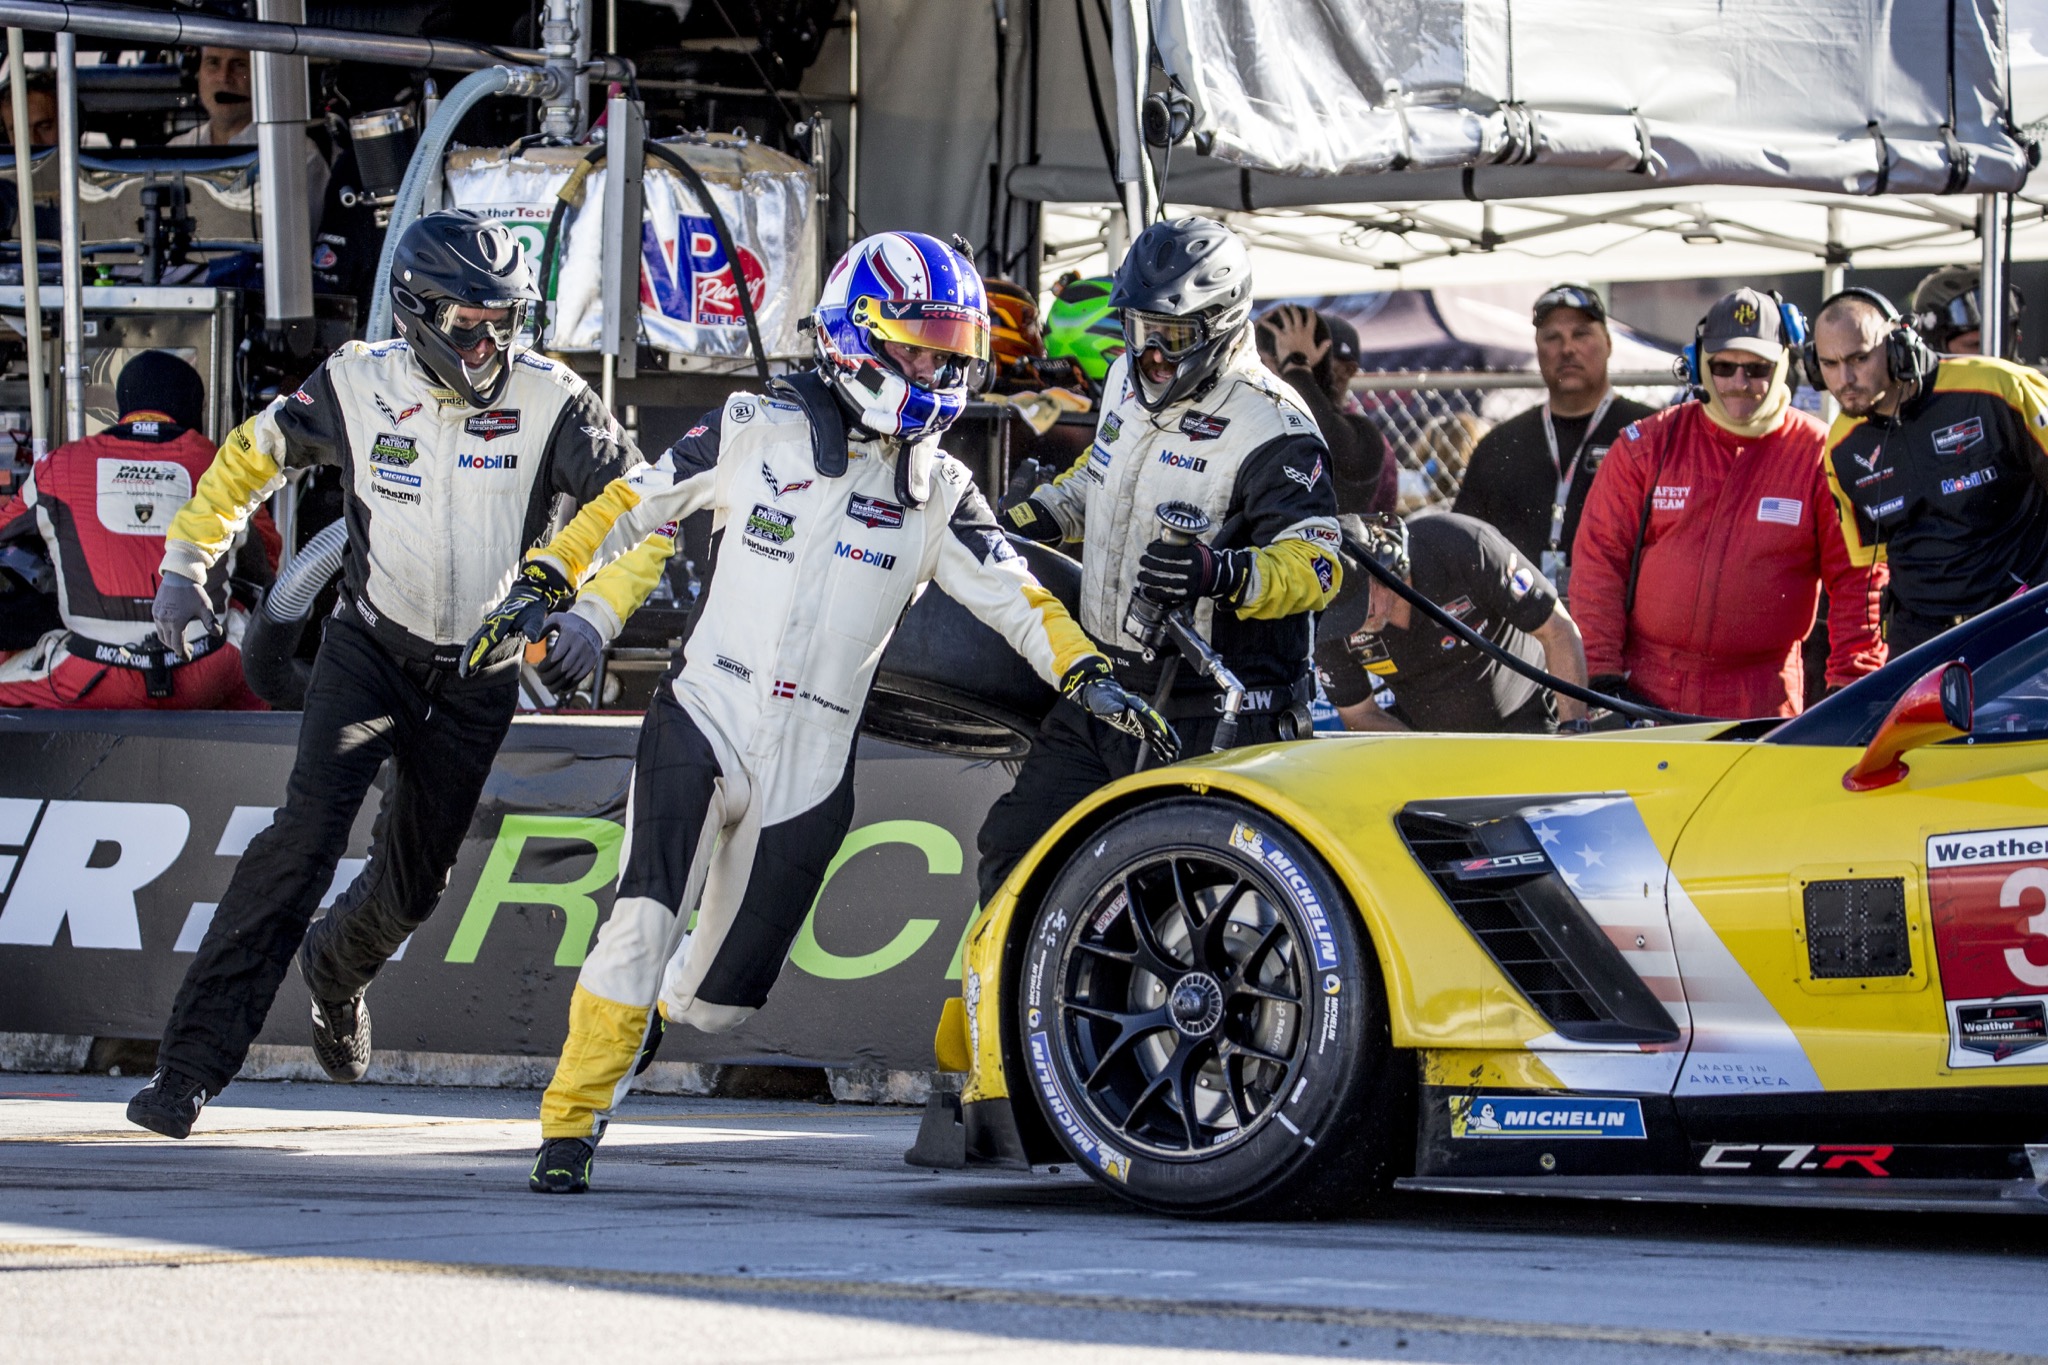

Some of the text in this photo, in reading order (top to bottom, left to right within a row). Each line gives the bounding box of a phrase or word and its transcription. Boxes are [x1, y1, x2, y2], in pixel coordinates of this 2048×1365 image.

[700, 312, 747, 327] FUELS
[133, 422, 159, 433] OMP
[458, 454, 502, 470] Mobil
[1158, 449, 1195, 470] Mobil
[116, 471, 176, 481] MILLER
[120, 465, 160, 474] PAUL
[381, 470, 421, 485] MICHELIN
[1940, 471, 1982, 495] Mobil
[1655, 486, 1691, 497] AFETY
[1653, 499, 1685, 510] TEAM
[833, 541, 884, 566] Mobil
[435, 654, 457, 663] Steve
[1117, 657, 1131, 668] Dix
[812, 693, 850, 715] Magnussen
[1461, 851, 1545, 871] Z06
[1267, 850, 1337, 963] MICHELIN
[2000, 867, 2048, 987] 3
[1029, 963, 1040, 1006] MICHELIN
[1327, 996, 1339, 1041] MICHELIN
[1963, 1018, 2044, 1033] WeatherTech
[1270, 1018, 1286, 1054] RACIN
[1698, 1064, 1768, 1073] MADE IN
[1689, 1075, 1790, 1087] AMERICA
[1031, 1040, 1095, 1153] MICHELIN
[1503, 1110, 1626, 1127] MICHELIN
[1699, 1144, 1895, 1177] C7.R
